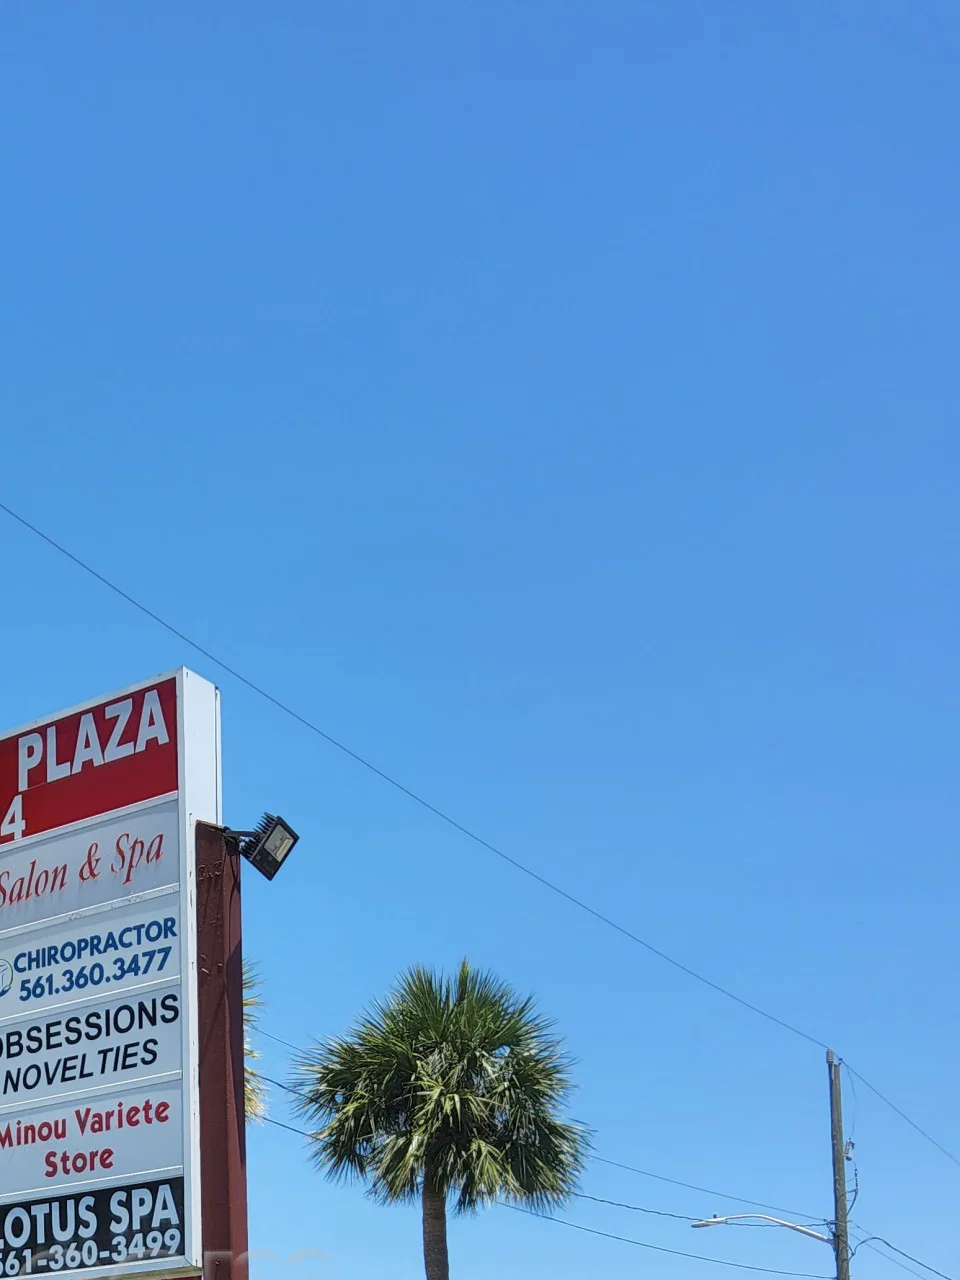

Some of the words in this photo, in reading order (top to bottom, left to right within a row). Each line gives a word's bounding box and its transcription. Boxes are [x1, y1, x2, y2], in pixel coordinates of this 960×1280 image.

[18, 689, 170, 793] PLAZA
[78, 842, 102, 883] &
[110, 832, 165, 886] Spa
[13, 917, 178, 974] CHIROPRACTOR
[19, 945, 173, 1002] 561.360.3477
[2, 1038, 159, 1095] NOVELTIES
[74, 1098, 170, 1137] Variete
[44, 1148, 114, 1178] Store
[109, 1183, 180, 1234] SPA
